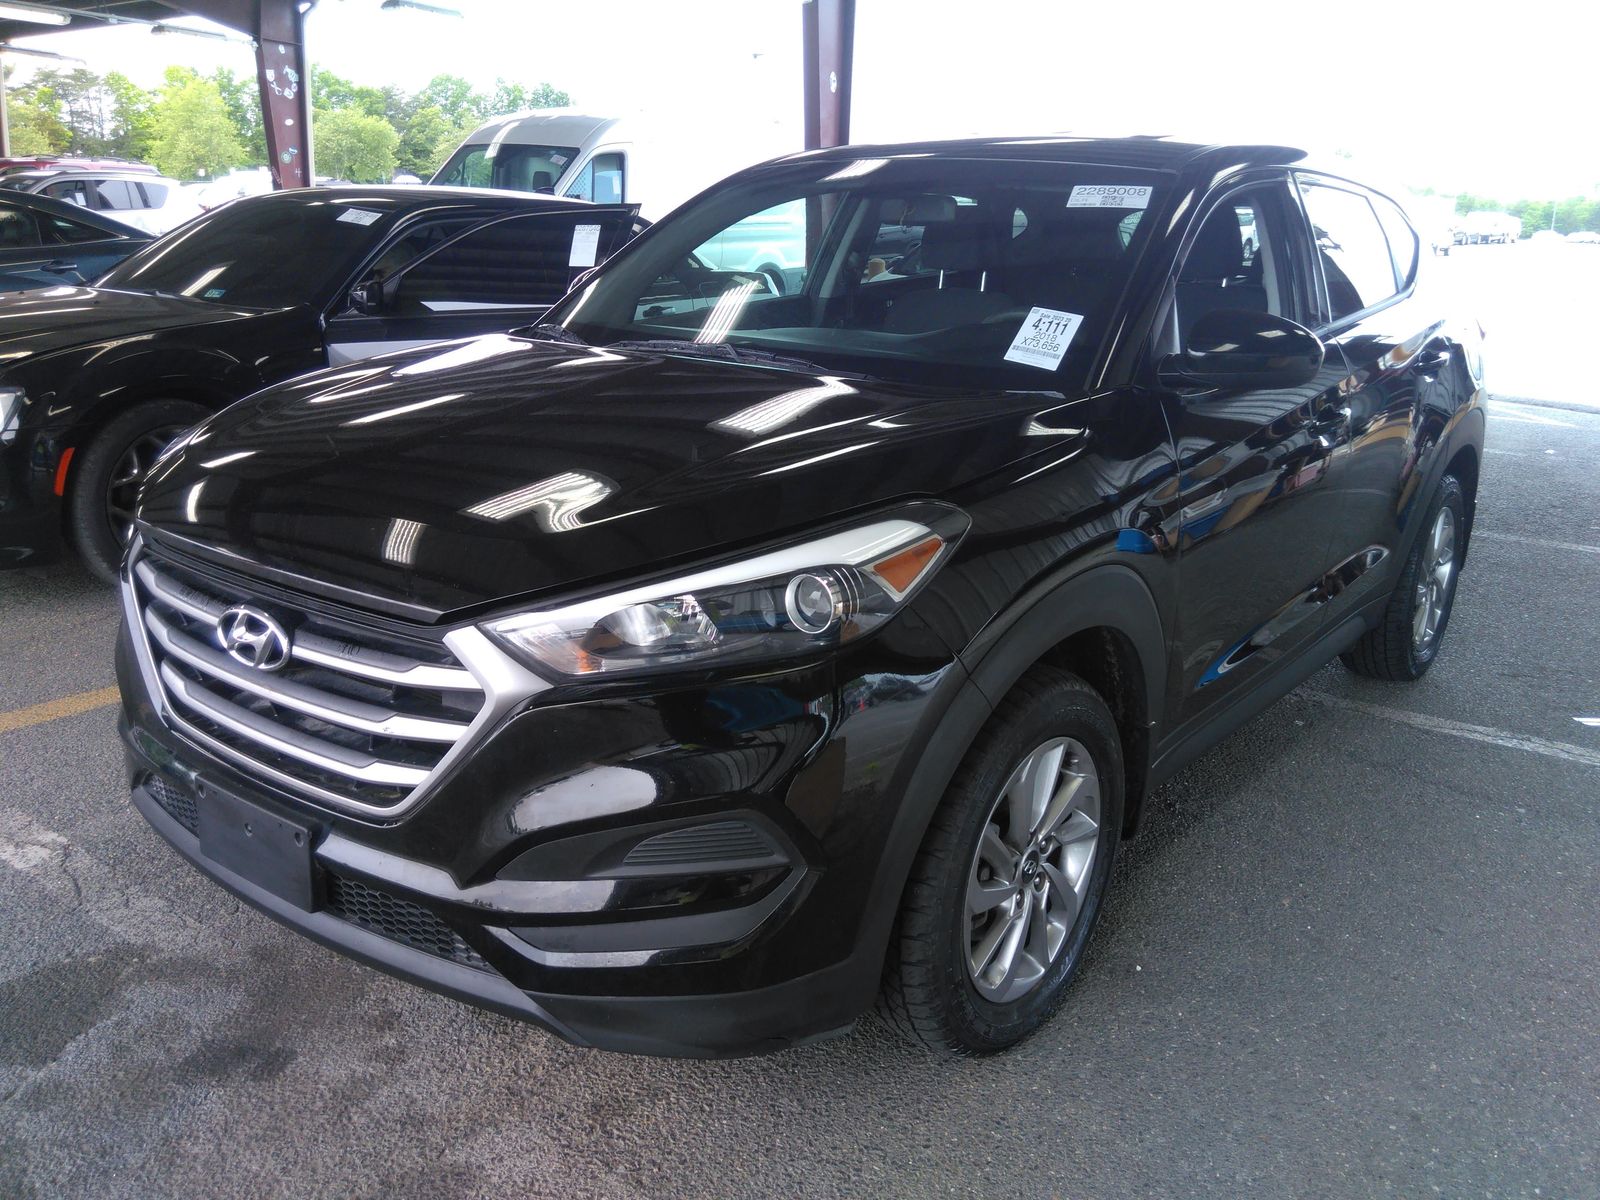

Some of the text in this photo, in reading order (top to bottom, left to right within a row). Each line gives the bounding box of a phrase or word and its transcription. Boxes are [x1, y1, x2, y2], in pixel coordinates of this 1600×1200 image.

[1076, 187, 1147, 196] 2289008
[1032, 317, 1069, 336] 4:111
[1033, 331, 1058, 342] 2018
[1021, 336, 1061, 352] X73,656
